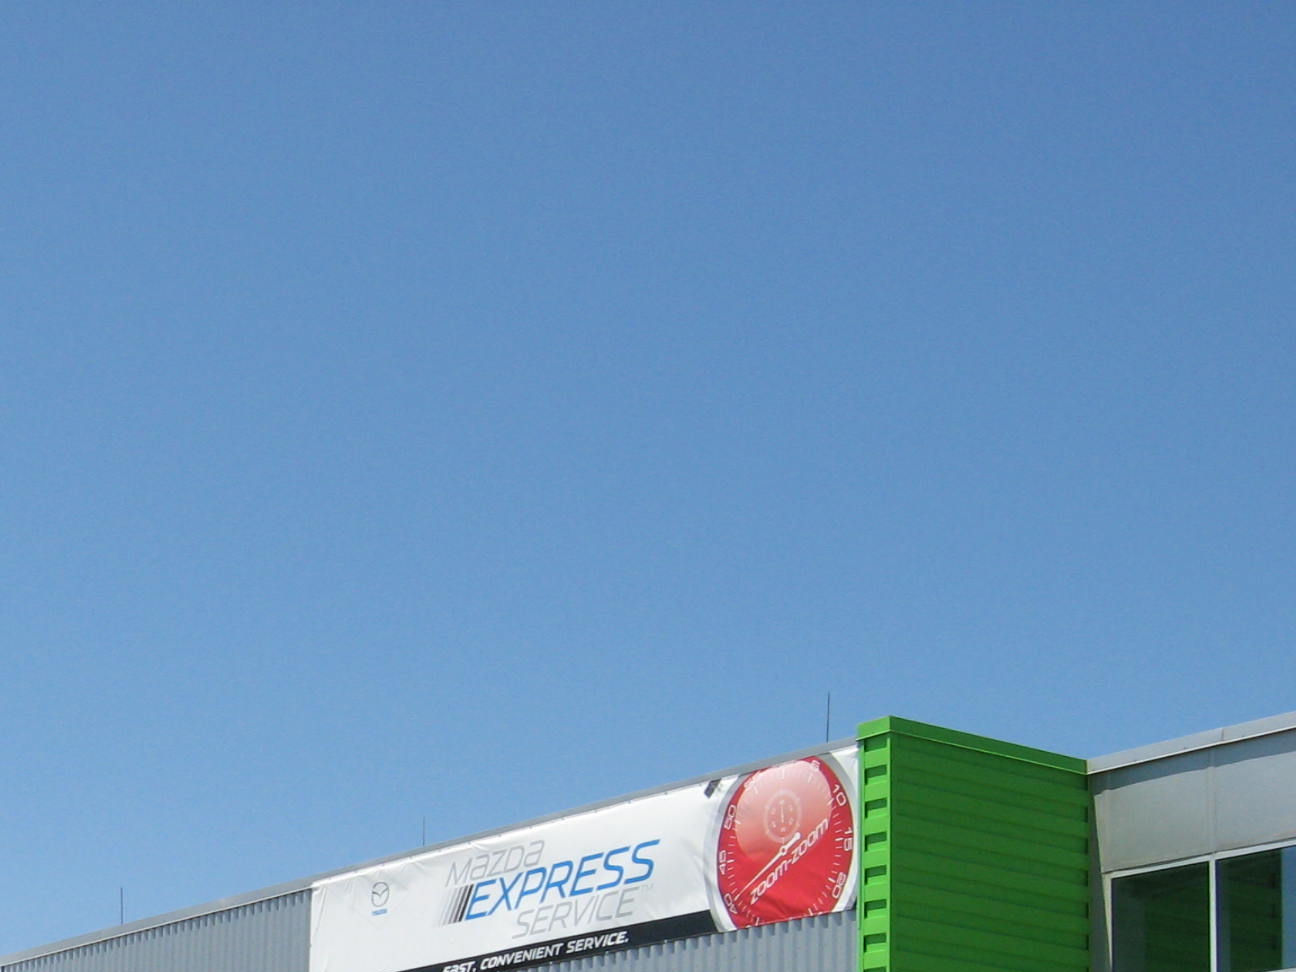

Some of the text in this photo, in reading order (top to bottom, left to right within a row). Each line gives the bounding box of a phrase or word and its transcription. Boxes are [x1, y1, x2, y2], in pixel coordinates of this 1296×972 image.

[465, 839, 661, 921] EXPRESS
[512, 886, 641, 939] SERVICE
[480, 942, 564, 971] CONVENIENT
[566, 931, 630, 954] SERVICE.
